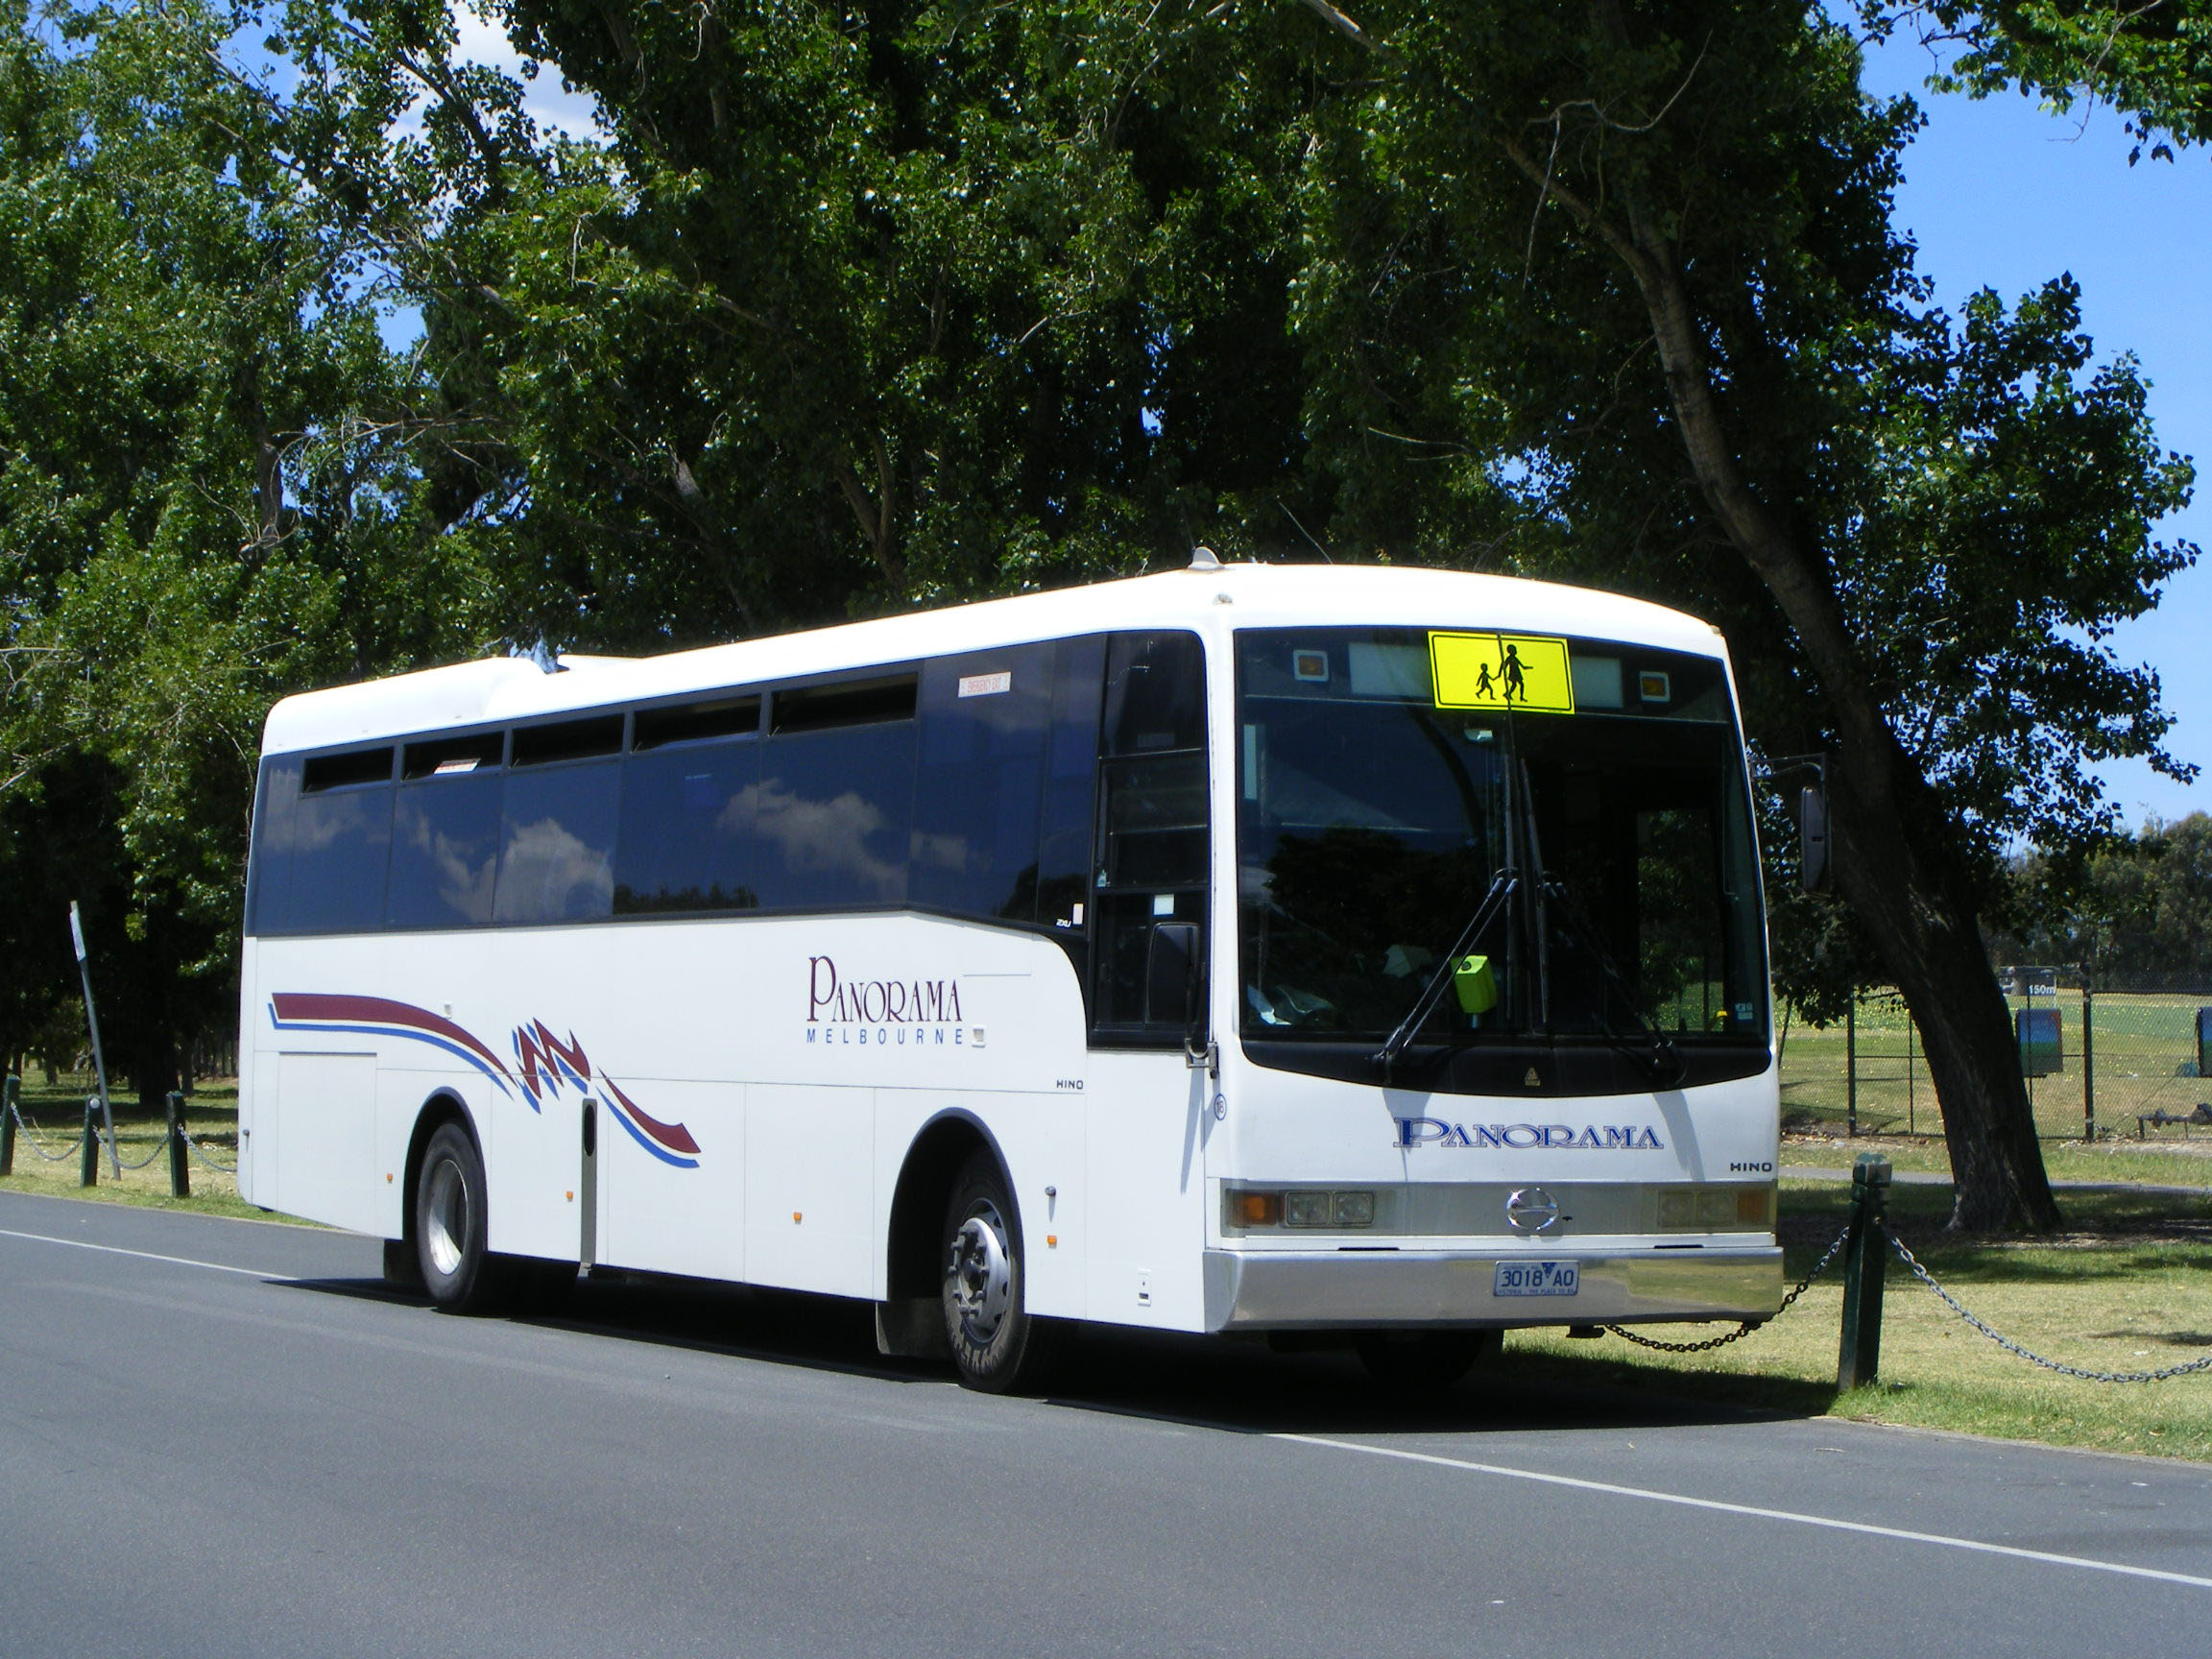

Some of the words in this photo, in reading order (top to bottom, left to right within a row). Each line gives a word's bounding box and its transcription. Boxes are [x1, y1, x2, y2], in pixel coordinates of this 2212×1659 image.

[806, 955, 963, 1023] PANORAMA
[2029, 984, 2056, 995] 150m
[806, 1028, 963, 1045] MELBOURNE
[1056, 1079, 1084, 1090] HINO
[1392, 1117, 1665, 1149] PANORAMA
[1730, 1162, 1772, 1172] HINO
[1501, 1269, 1543, 1286] 3018
